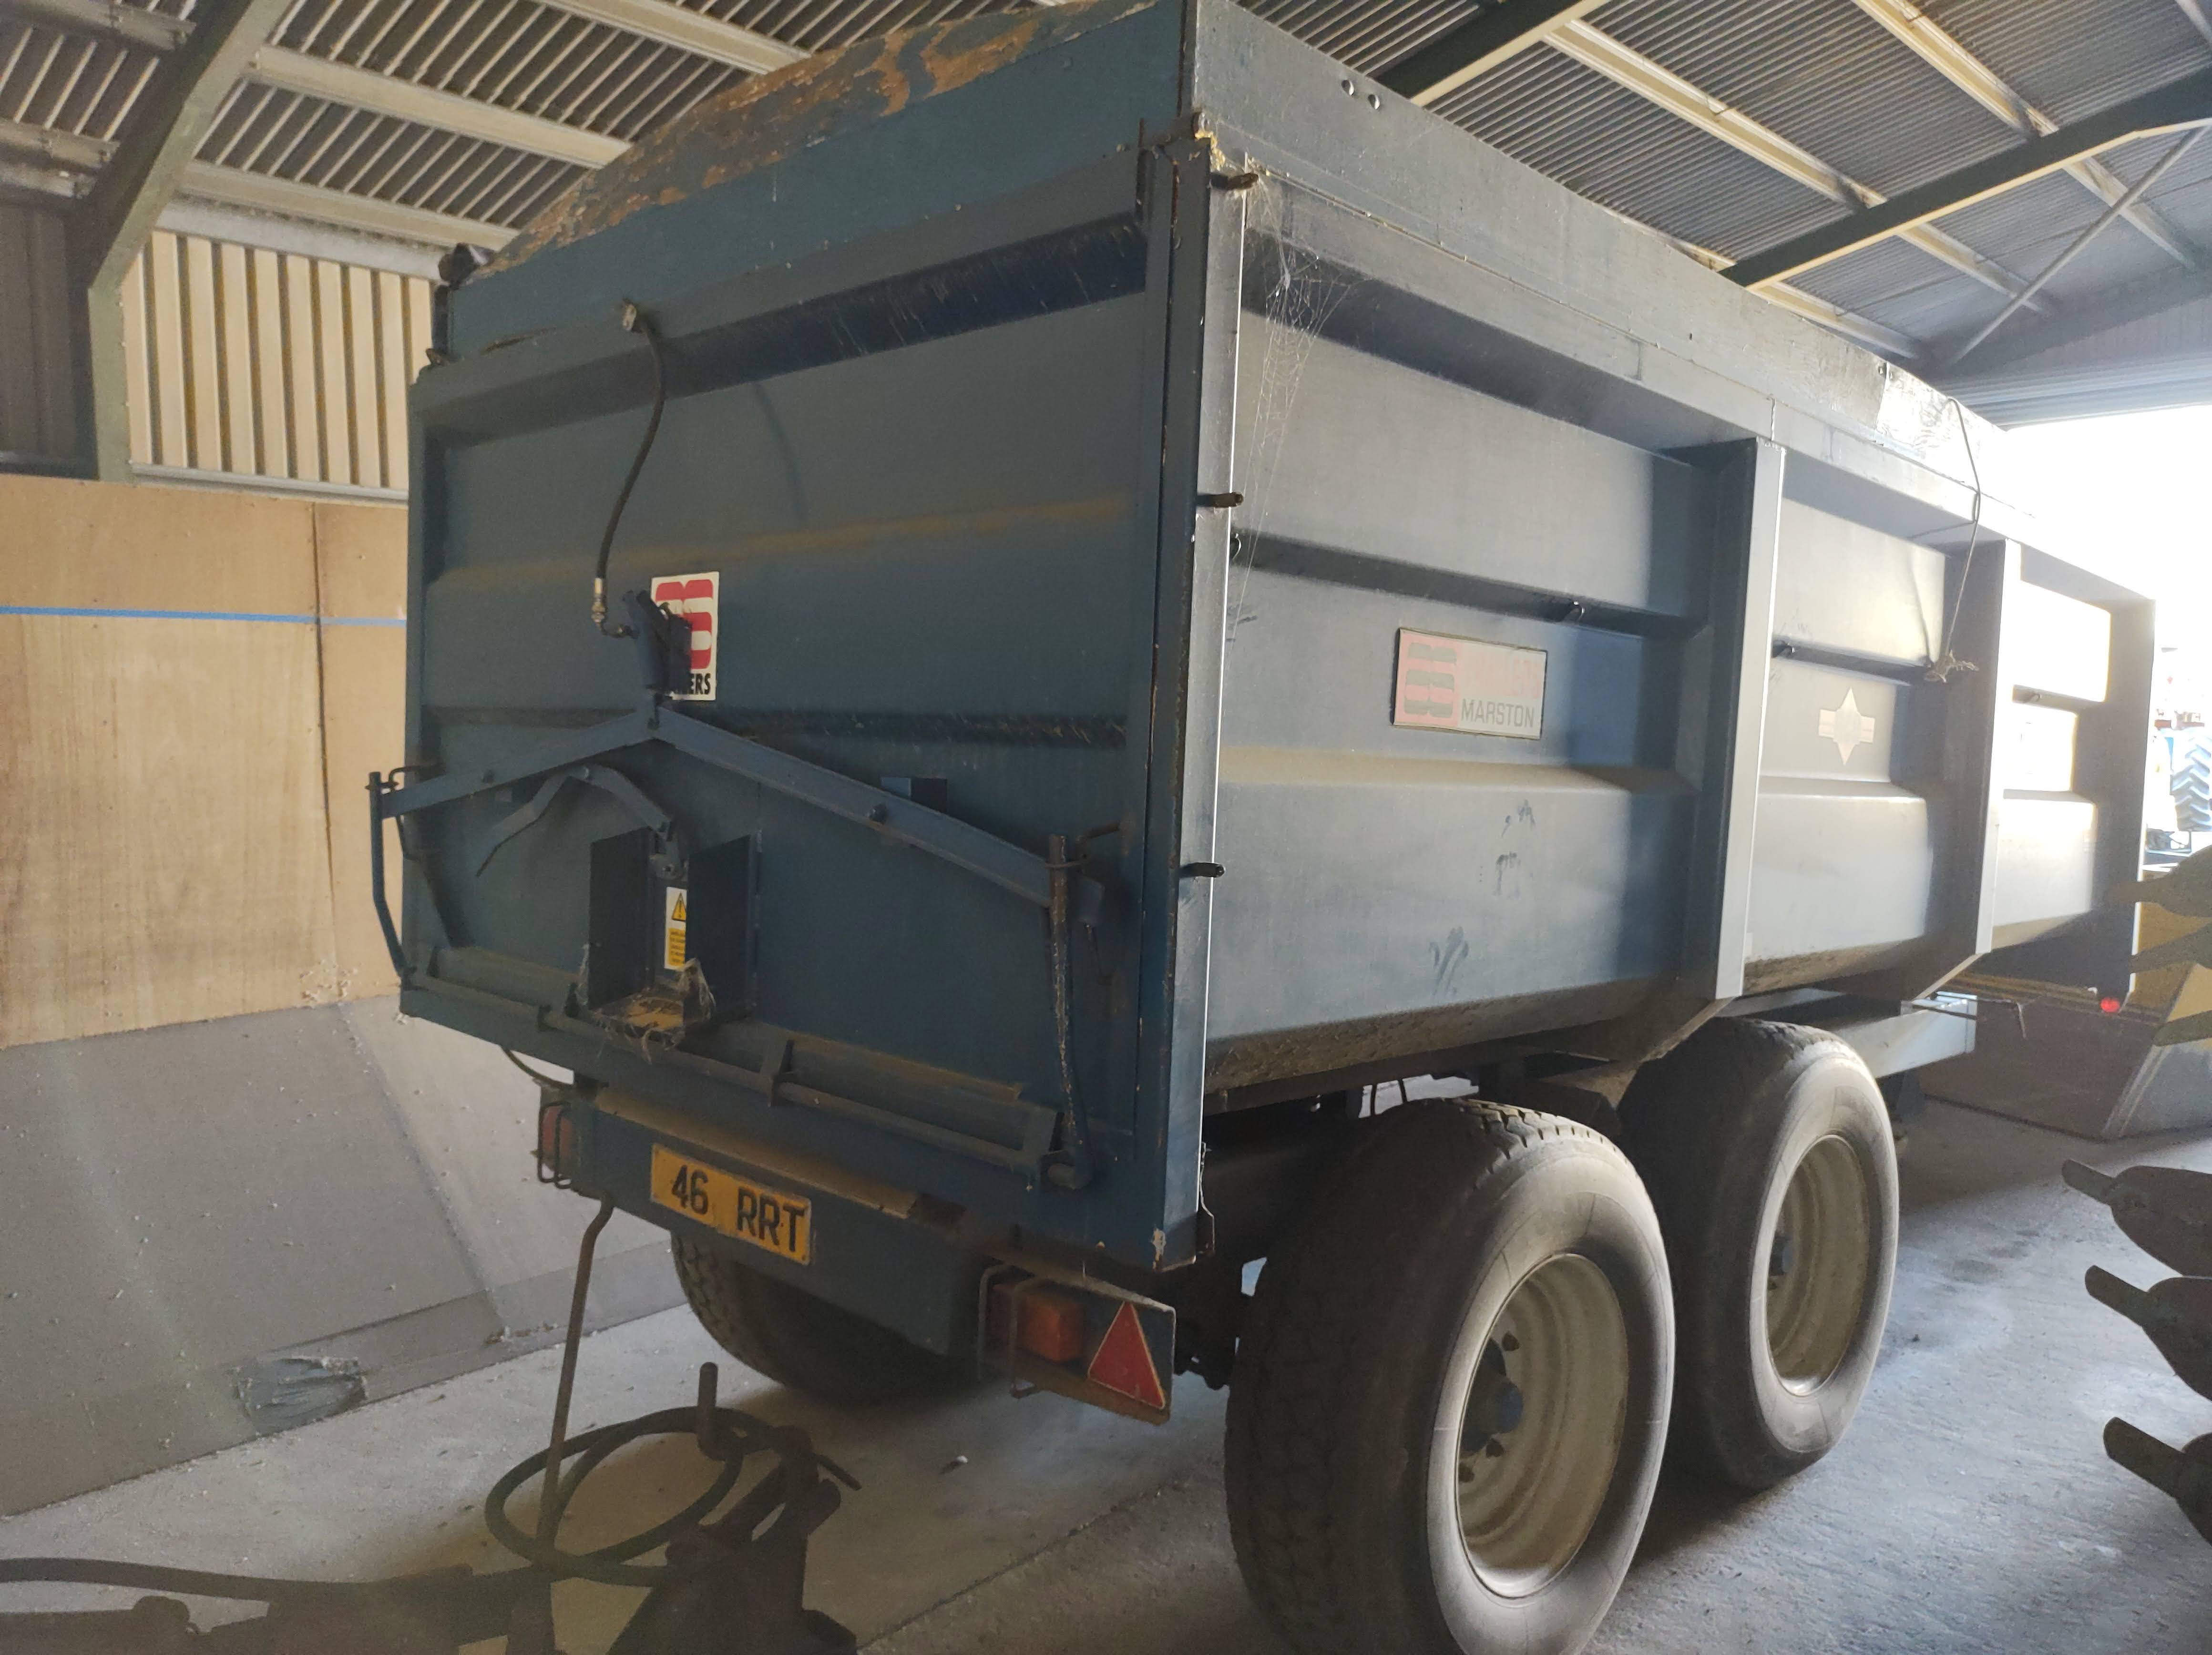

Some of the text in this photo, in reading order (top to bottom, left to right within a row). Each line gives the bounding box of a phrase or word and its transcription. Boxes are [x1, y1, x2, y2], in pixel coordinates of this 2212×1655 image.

[689, 673, 711, 695] ERS
[1461, 698, 1535, 728] MARSTON
[671, 1164, 808, 1252] 46 RRT
